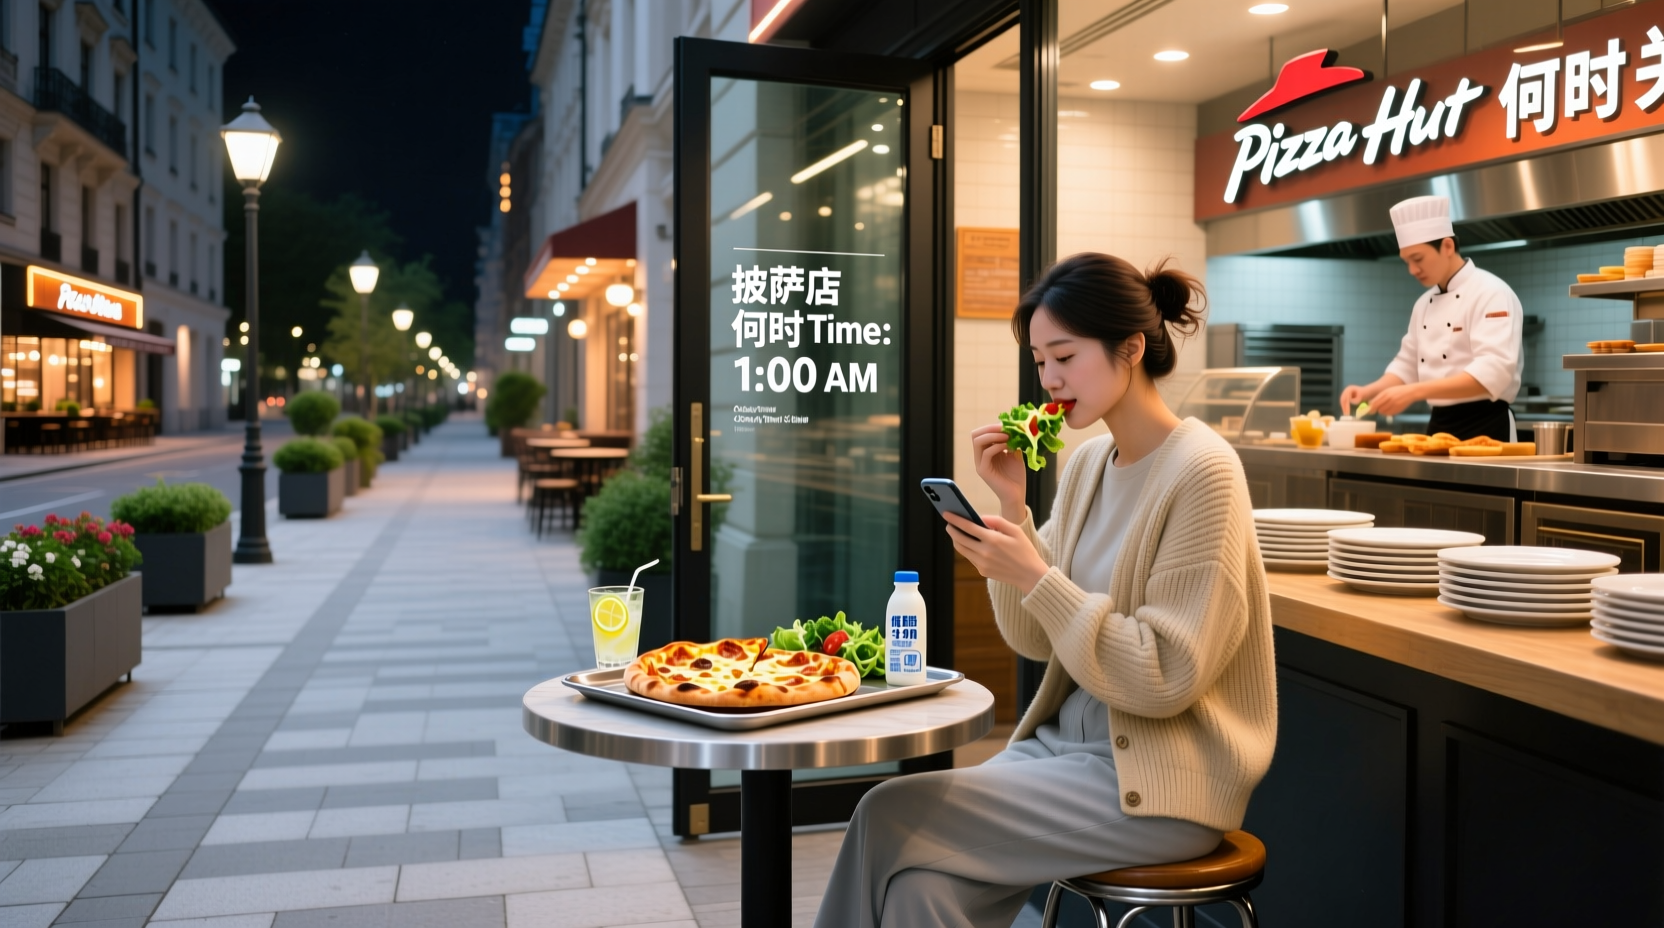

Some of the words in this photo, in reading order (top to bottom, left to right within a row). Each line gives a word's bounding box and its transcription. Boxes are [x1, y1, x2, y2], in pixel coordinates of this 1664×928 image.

[1223, 121, 1358, 204] Pizza
[1362, 78, 1484, 165] Hut
[731, 264, 842, 306] 披萨店
[734, 356, 817, 393] 1:00
[823, 362, 878, 393] AM
